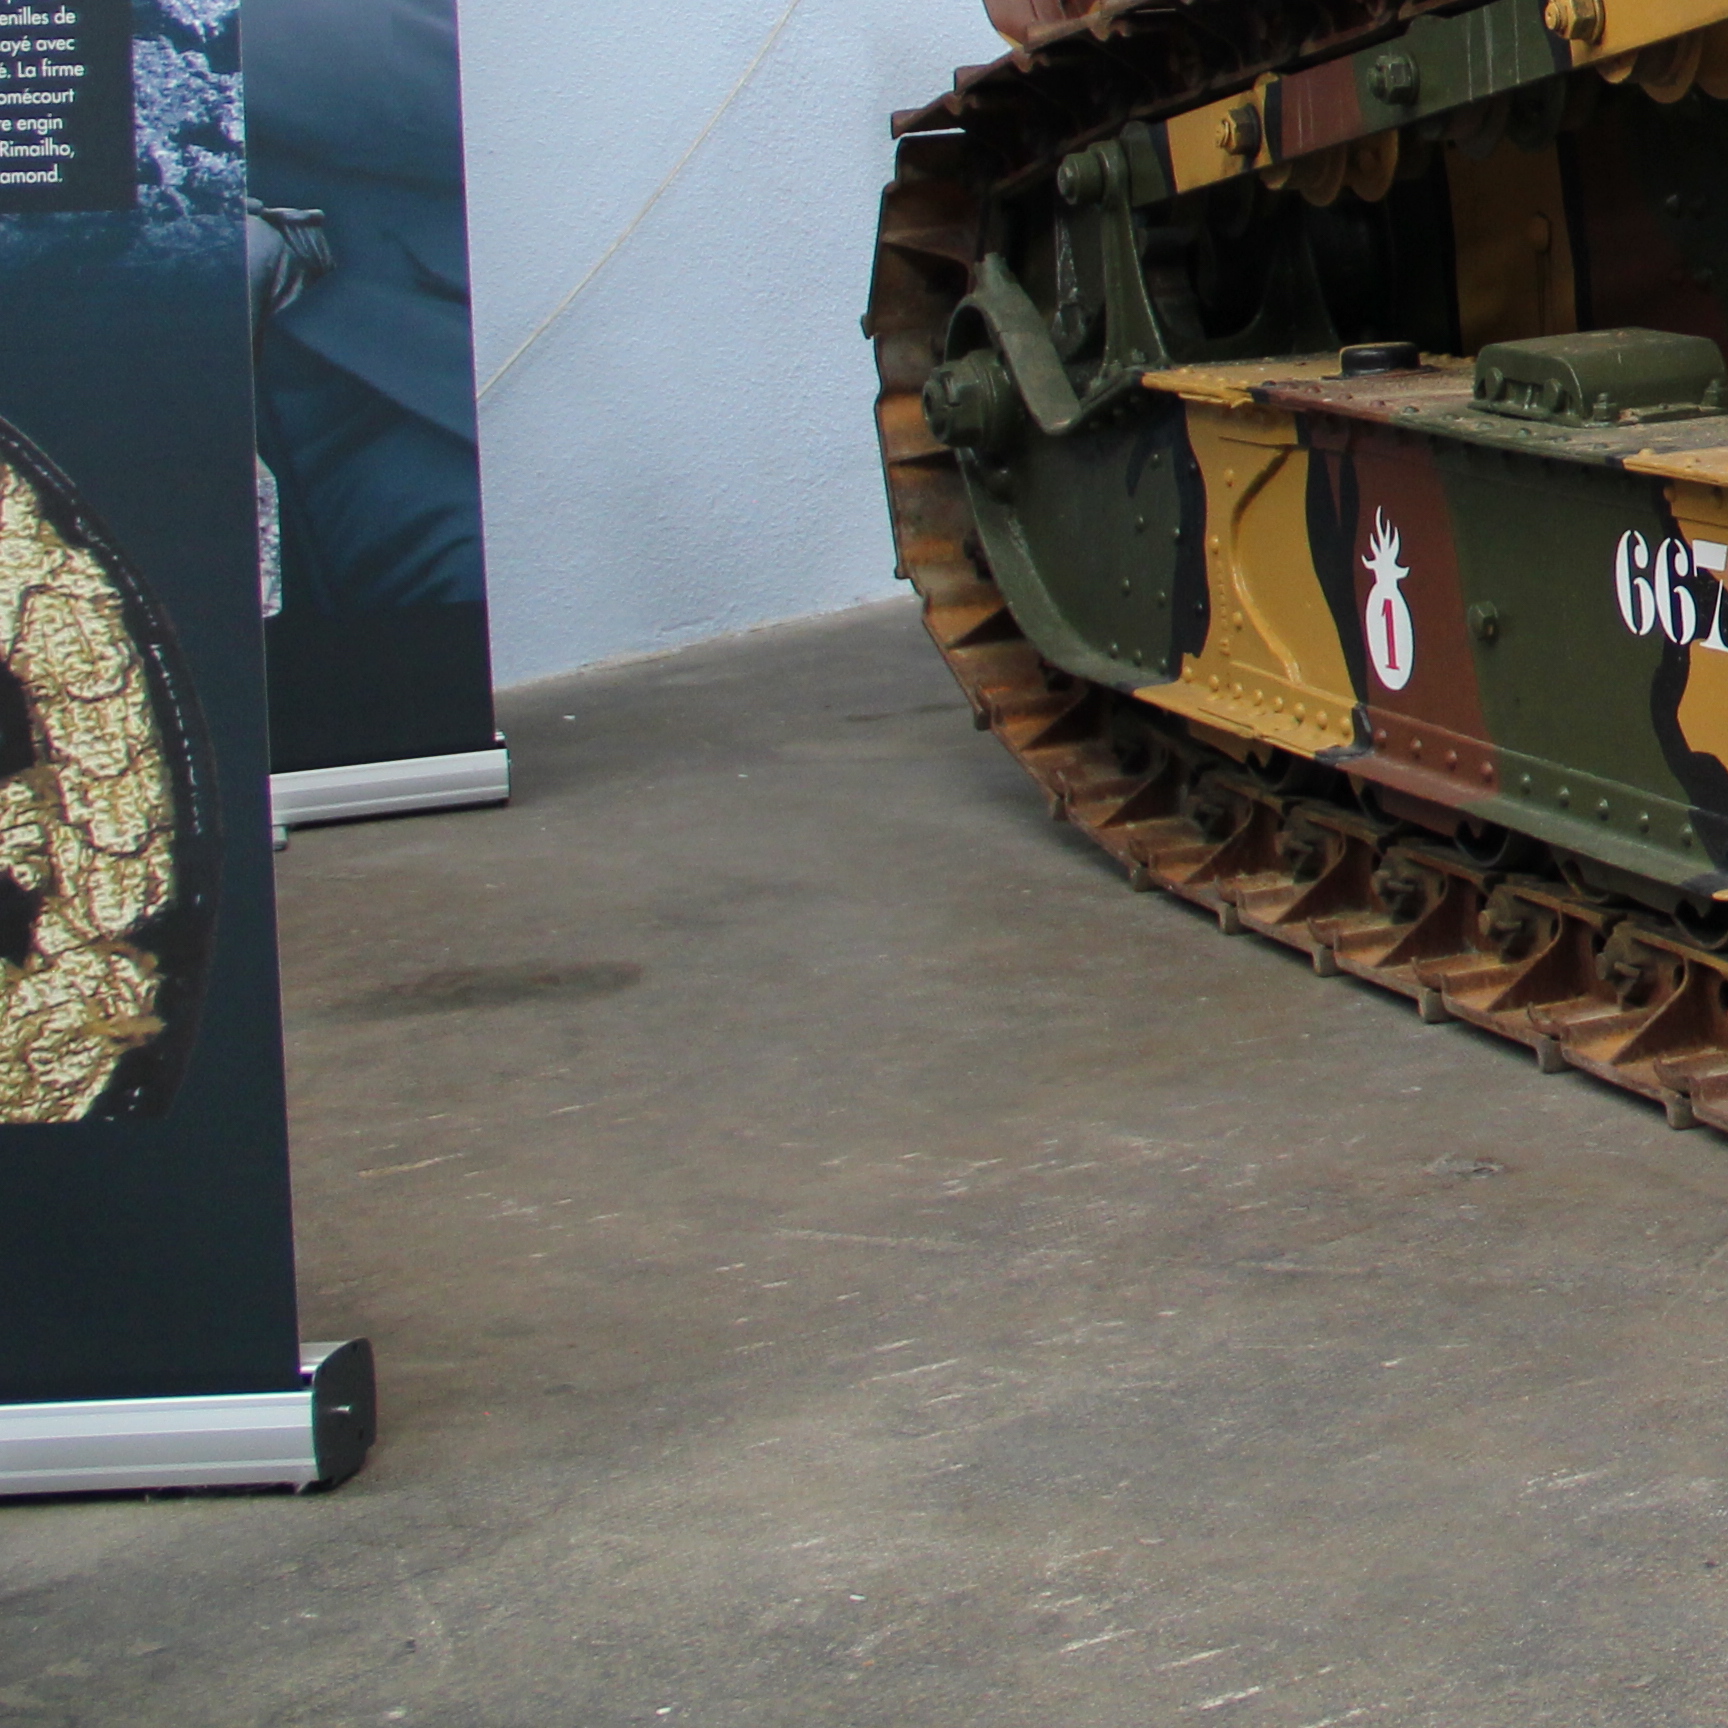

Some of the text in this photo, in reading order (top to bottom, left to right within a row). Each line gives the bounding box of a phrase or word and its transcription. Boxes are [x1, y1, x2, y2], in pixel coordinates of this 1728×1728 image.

[54, 5, 76, 24] de
[36, 39, 75, 51] avec
[18, 58, 84, 77] La firme
[17, 114, 62, 134] engin
[0, 137, 74, 158] Rimailho,
[1380, 598, 1400, 670] 1
